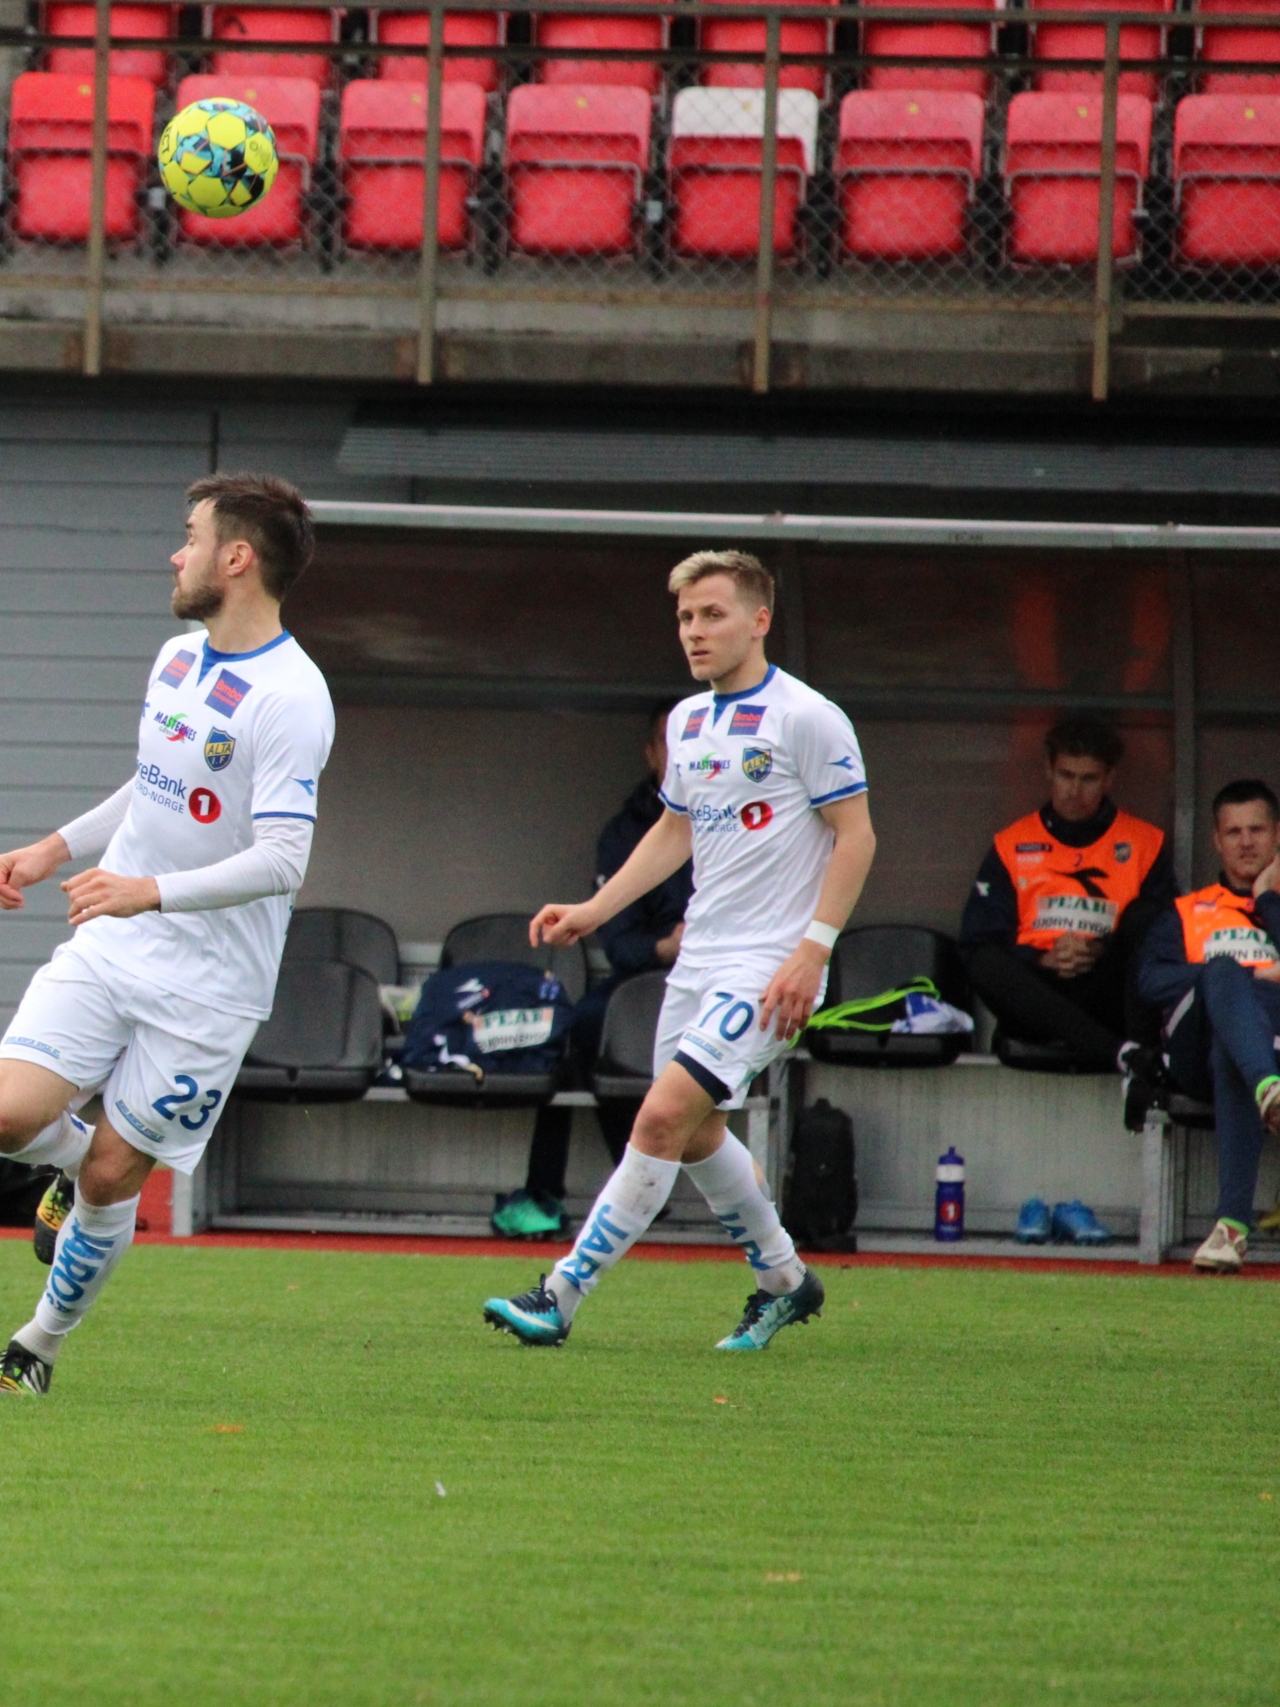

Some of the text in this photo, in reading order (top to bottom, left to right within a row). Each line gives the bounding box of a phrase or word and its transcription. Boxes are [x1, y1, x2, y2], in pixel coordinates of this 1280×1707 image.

[153, 711, 197, 742] MASTERNES
[206, 742, 232, 756] ALTA
[698, 991, 755, 1042] 70
[151, 1074, 222, 1131] 23
